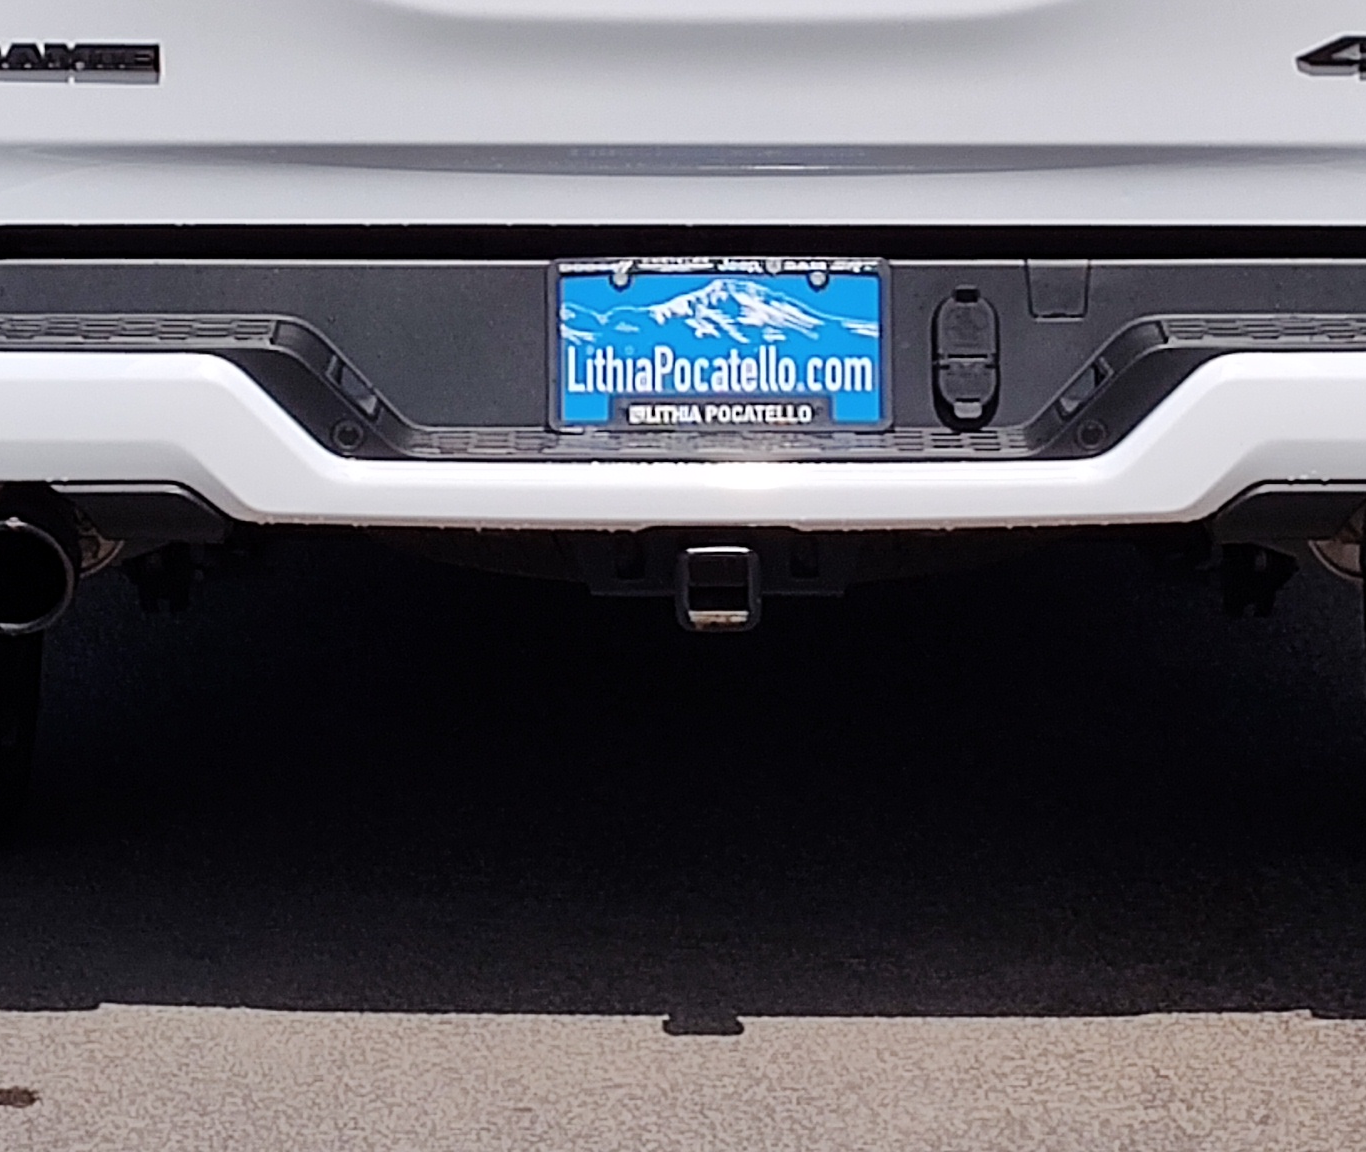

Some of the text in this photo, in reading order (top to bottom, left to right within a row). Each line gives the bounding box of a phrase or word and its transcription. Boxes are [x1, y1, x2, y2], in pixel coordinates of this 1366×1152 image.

[567, 344, 874, 393] LithiaPocatello.com
[646, 404, 813, 425] LITHIA POCATELLO
